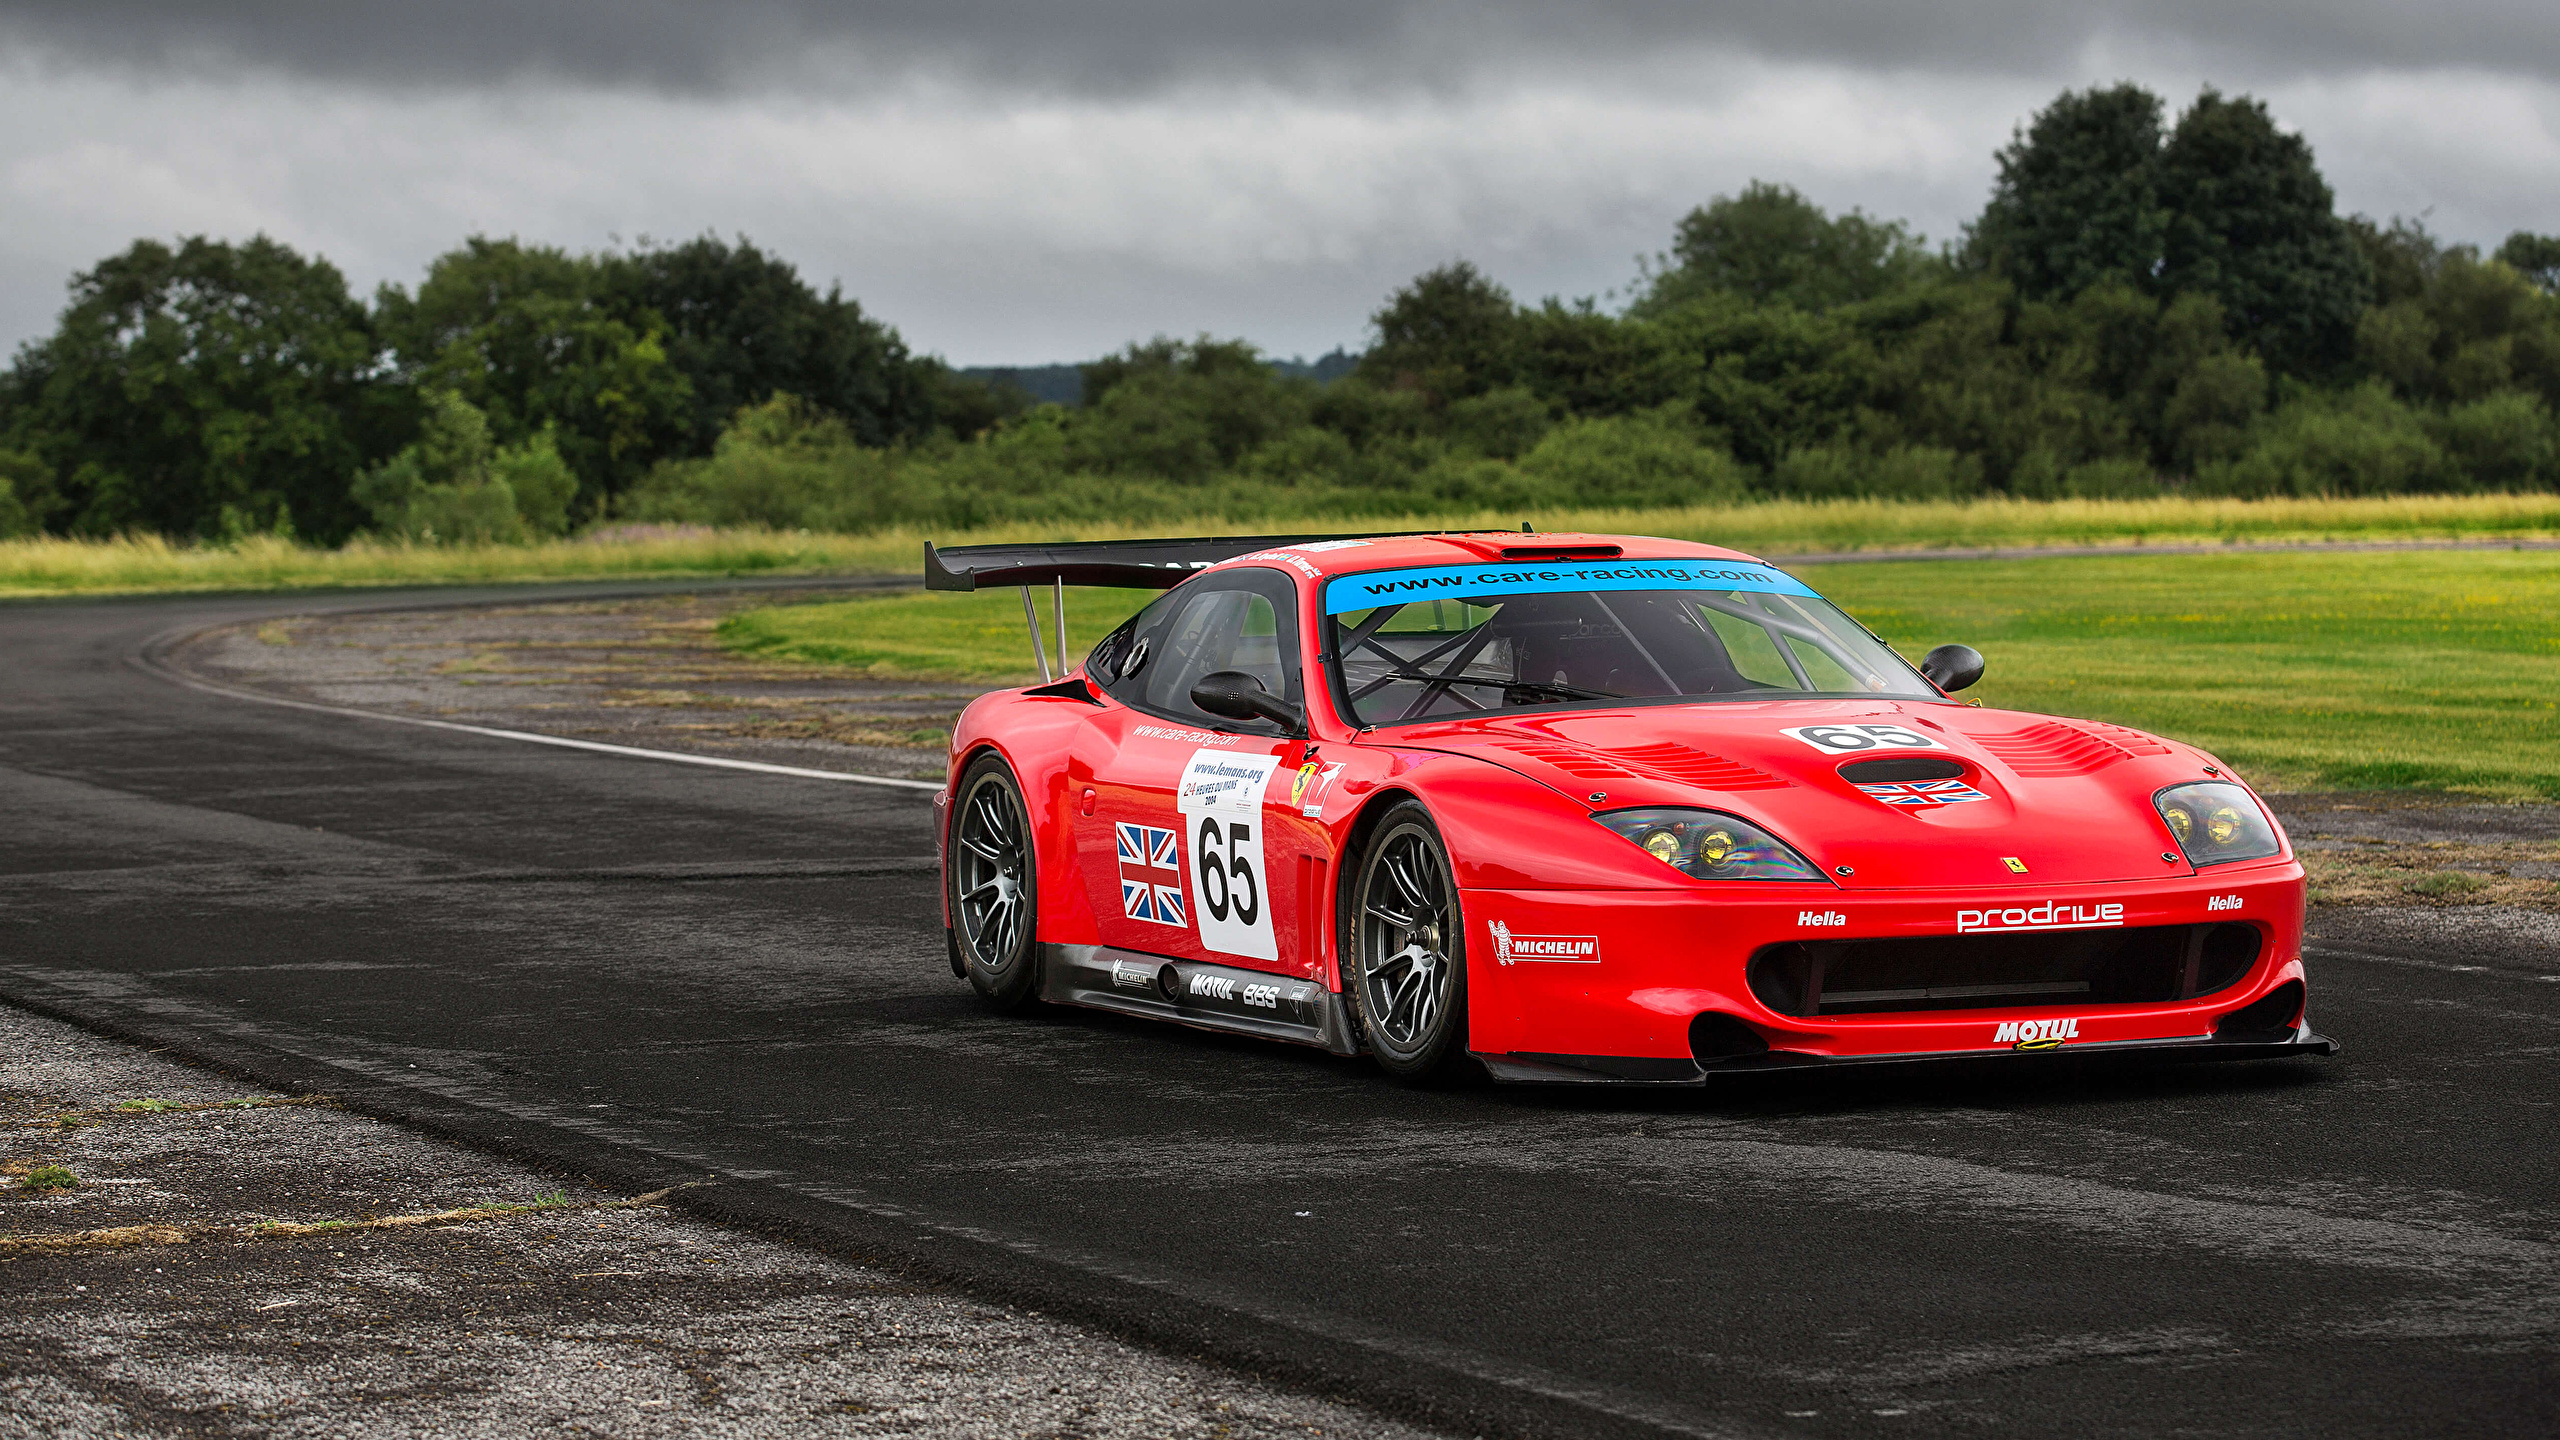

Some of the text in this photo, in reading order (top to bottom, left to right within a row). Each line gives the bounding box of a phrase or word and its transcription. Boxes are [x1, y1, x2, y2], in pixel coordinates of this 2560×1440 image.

[1363, 565, 1774, 595] www.care-racing.com
[1133, 725, 1241, 746] www.care-racing.com
[1799, 725, 1933, 749] 65
[1194, 762, 1264, 783] www.lemans.org
[1184, 782, 1196, 796] 24
[1199, 817, 1258, 926] 65
[2207, 895, 2243, 911] Hella
[1798, 911, 1847, 926] Hella
[1957, 900, 2124, 933] prodrive
[1514, 941, 1594, 955] MICHELIN
[1118, 971, 1148, 984] MICHELIN
[1190, 973, 1281, 1008] MOTUL BBS
[1993, 1018, 2079, 1042] MOTUL
